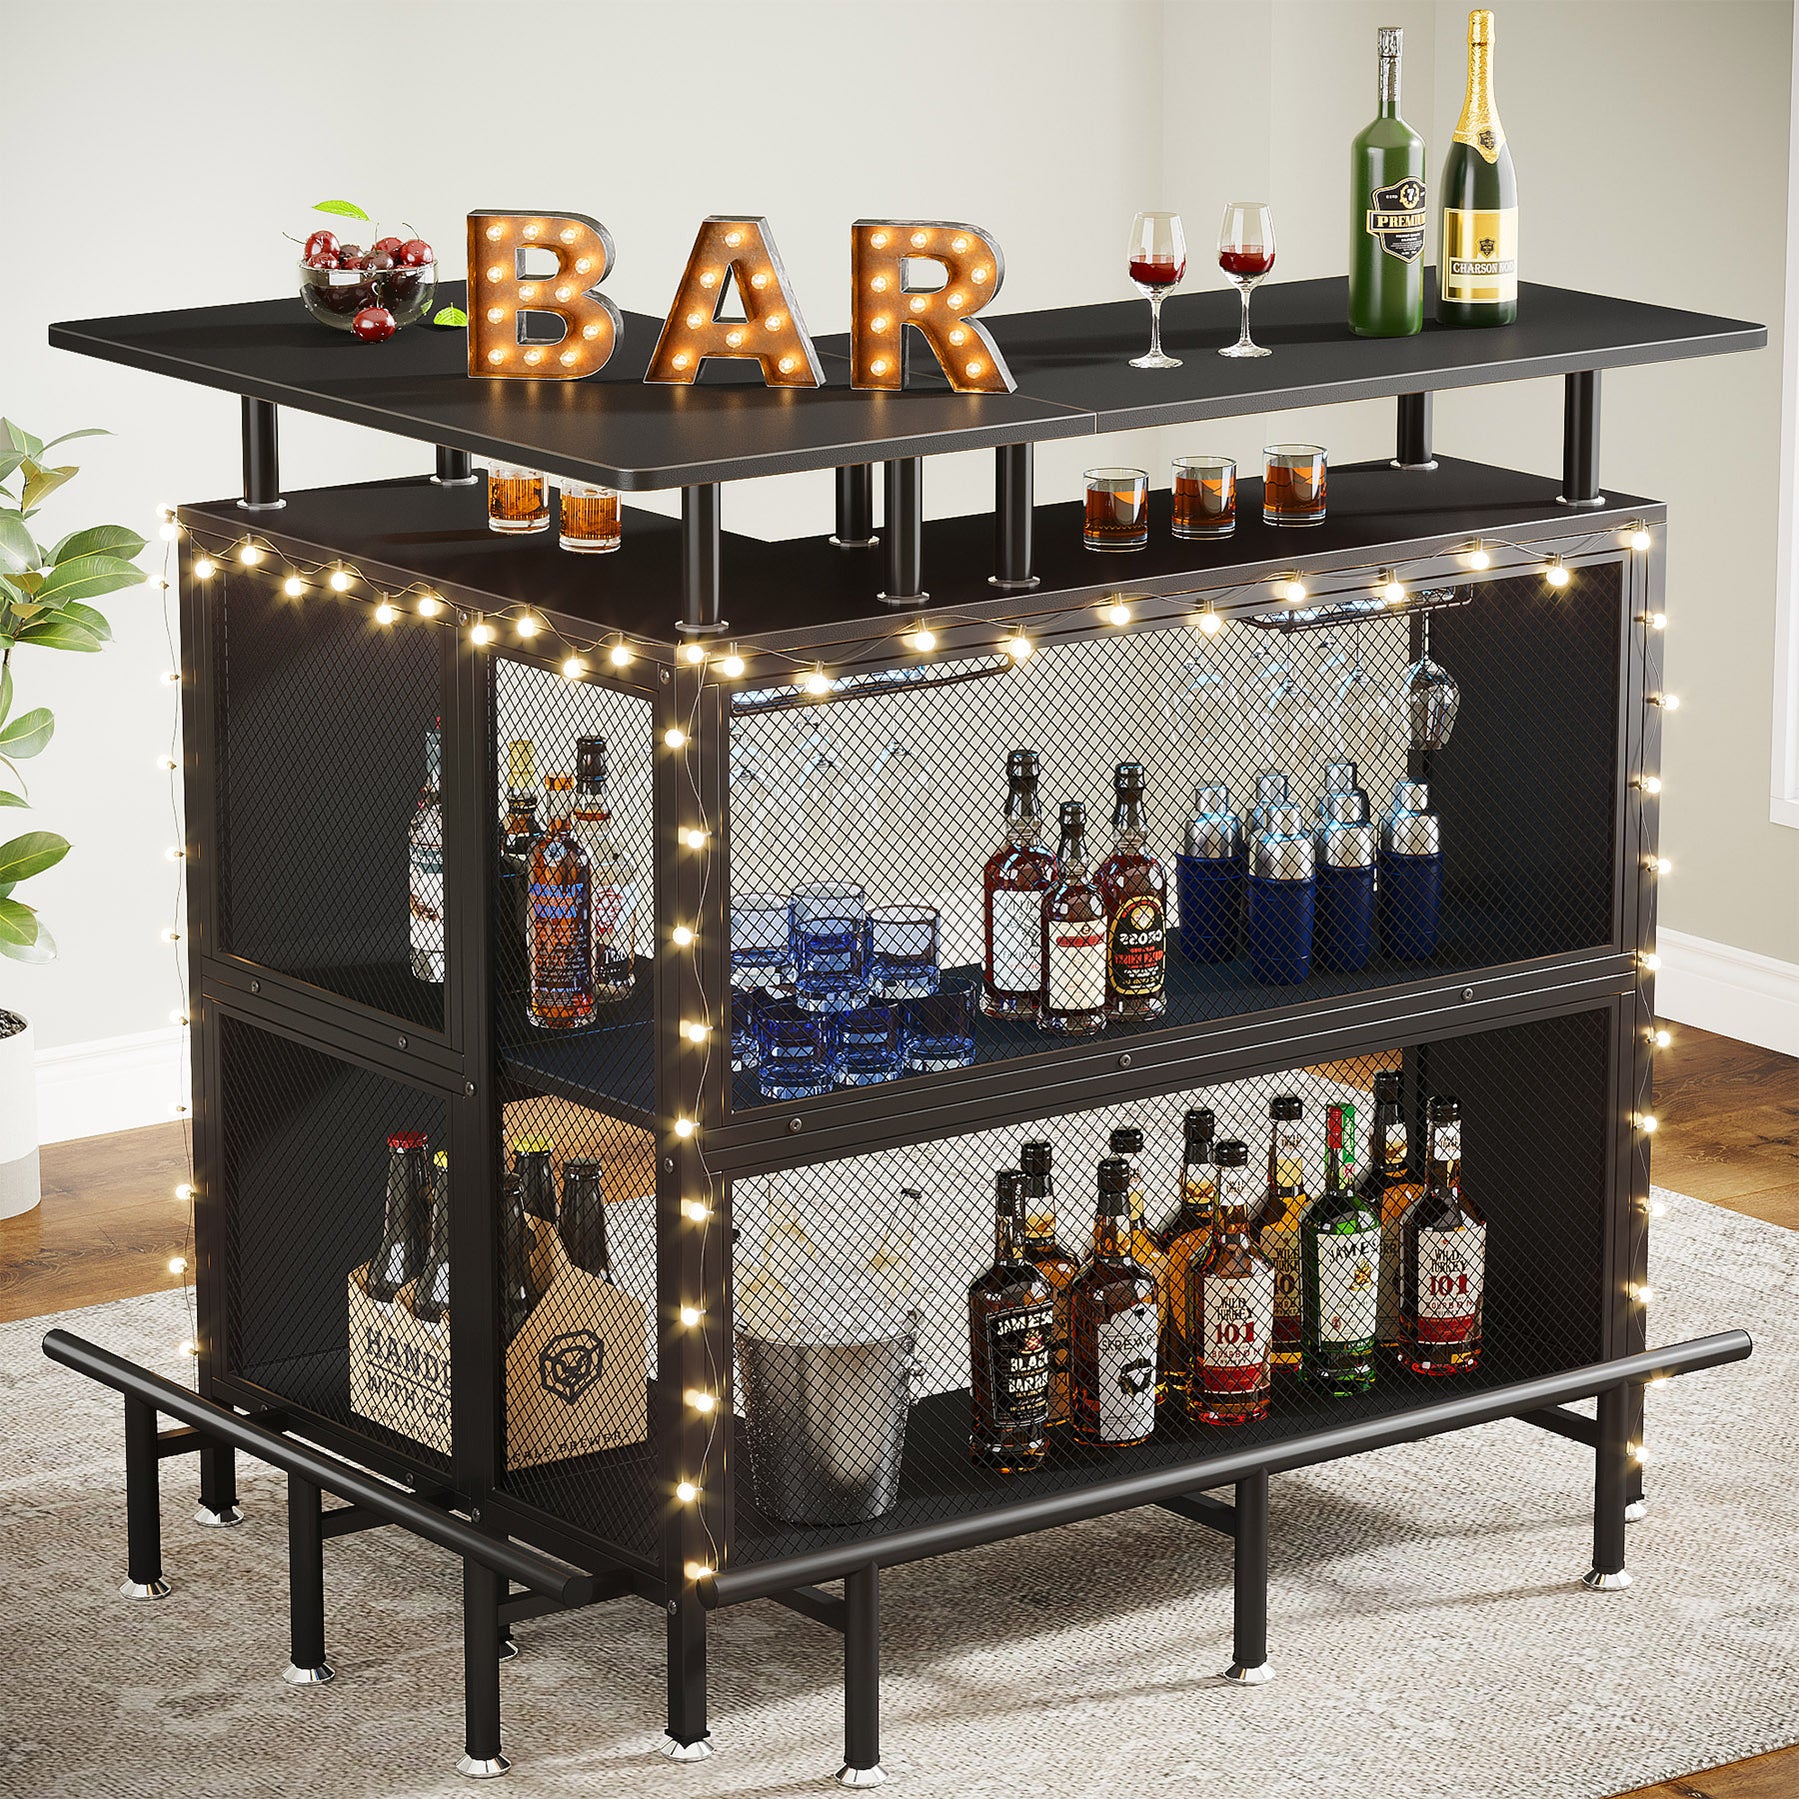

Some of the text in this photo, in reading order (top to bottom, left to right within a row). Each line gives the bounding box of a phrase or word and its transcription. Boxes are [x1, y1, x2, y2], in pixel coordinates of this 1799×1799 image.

[1452, 262, 1499, 274] CHARSON
[467, 209, 1018, 395] BAR
[1429, 1273, 1469, 1296] 101
[1217, 1321, 1255, 1344] 101
[366, 1326, 451, 1391] HANDL
[366, 1370, 416, 1411] WITH
